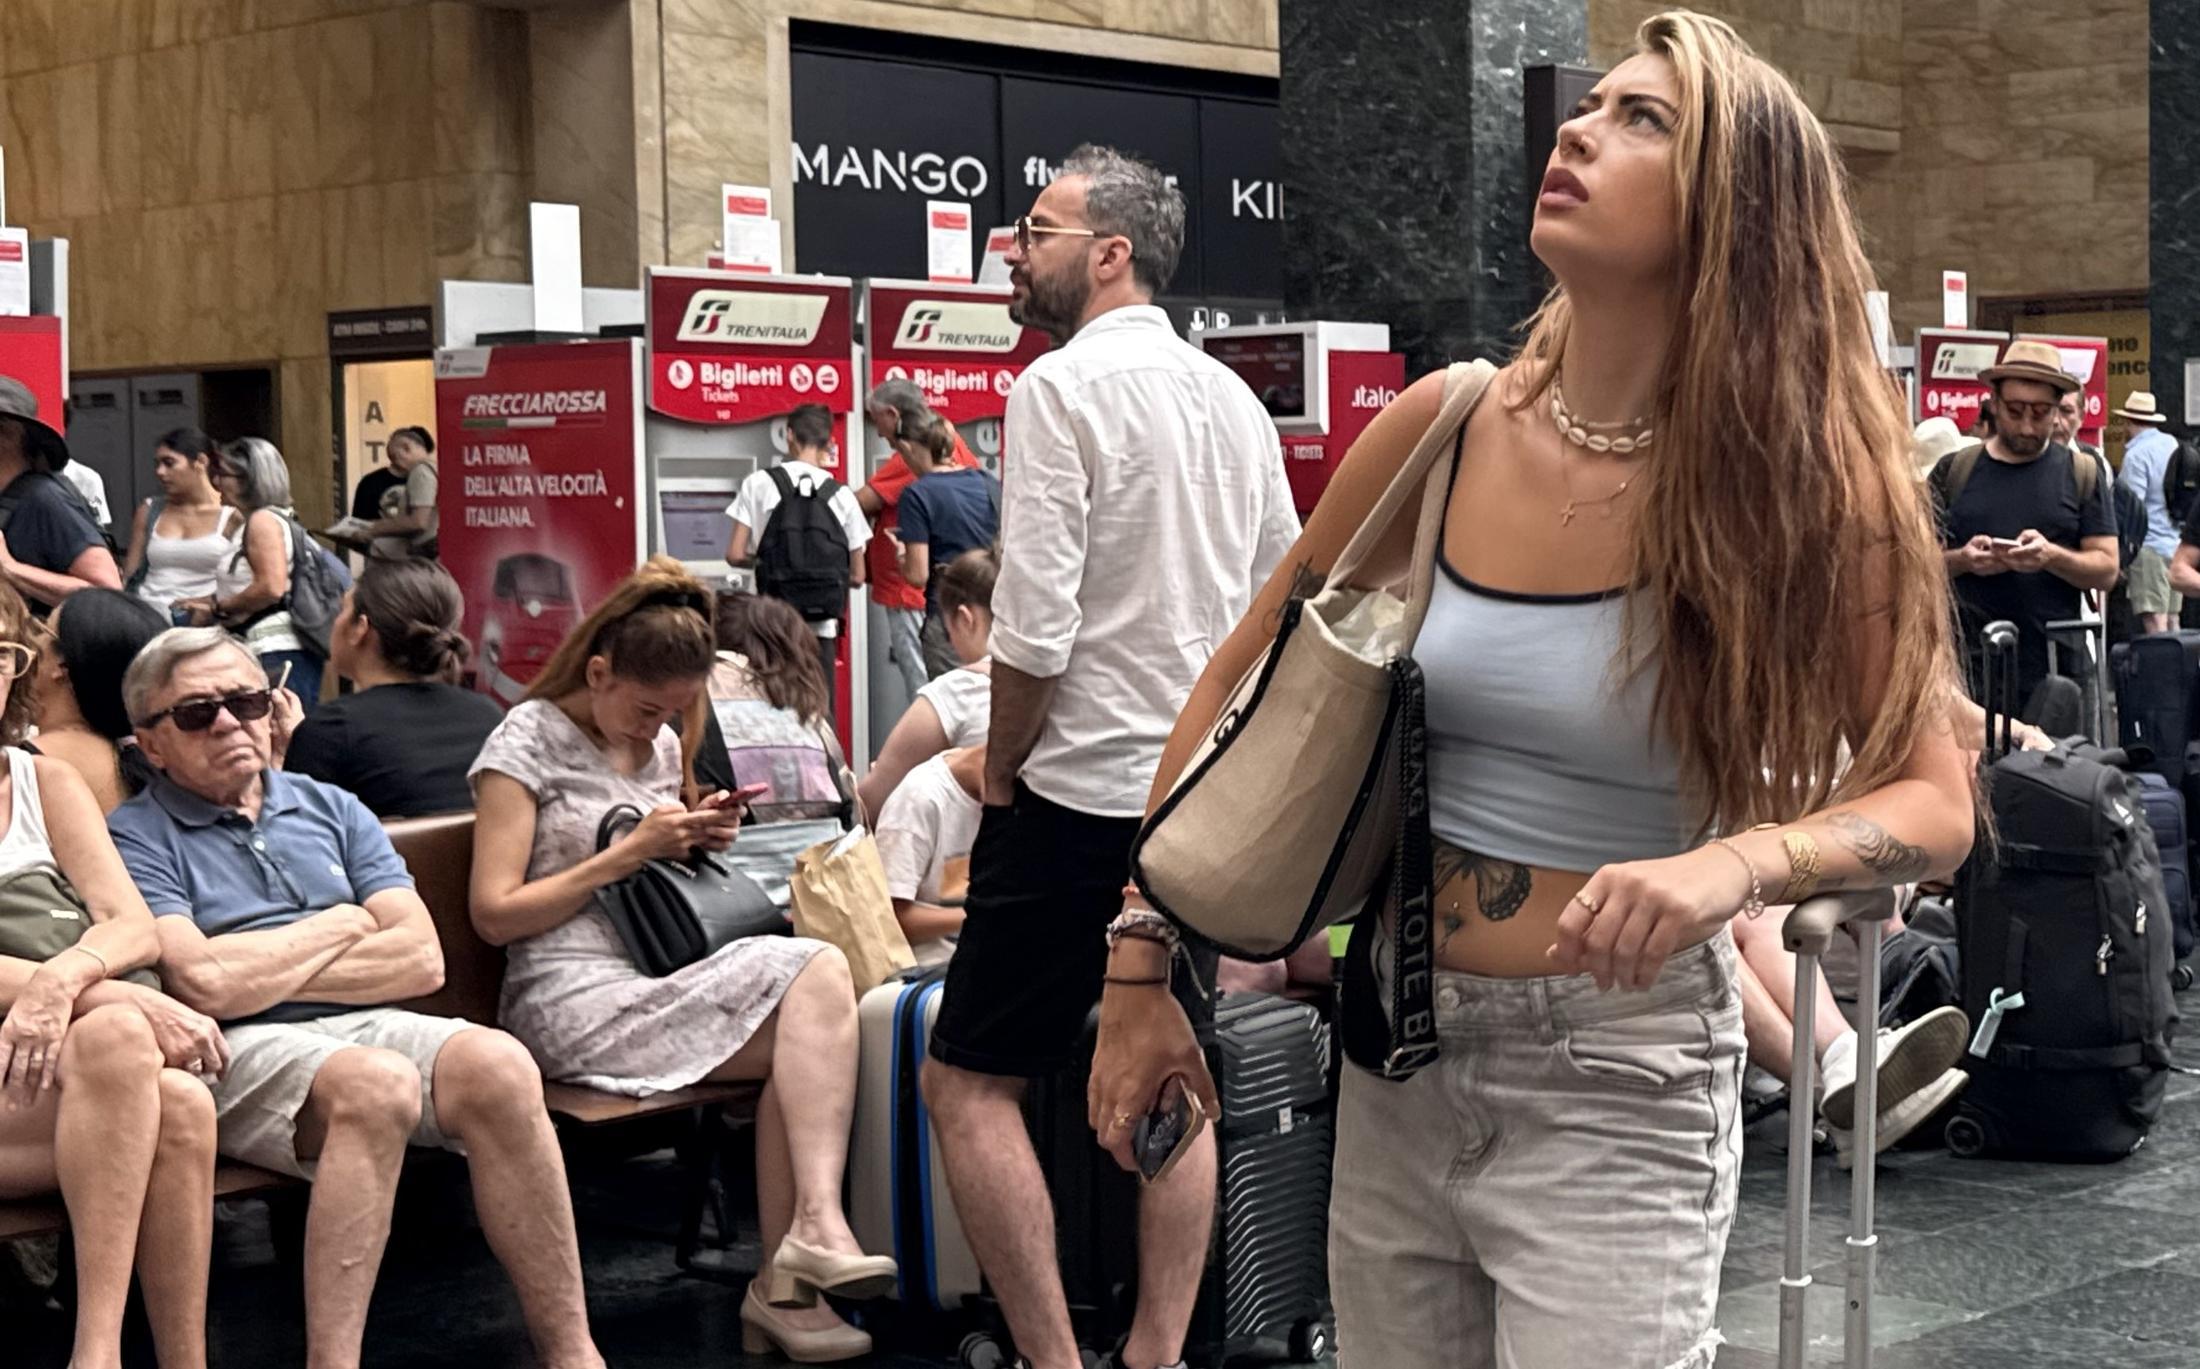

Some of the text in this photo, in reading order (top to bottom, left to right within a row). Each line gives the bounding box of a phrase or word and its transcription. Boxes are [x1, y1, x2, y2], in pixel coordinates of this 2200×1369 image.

[791, 142, 988, 197] MANGO
[726, 324, 808, 340] TRENITALIA
[938, 333, 1011, 348] TRENITALIA
[700, 362, 783, 391] Biglietti
[914, 368, 989, 395] Biglietti
[463, 390, 607, 417] FRECCIAROSSA
[464, 444, 532, 467] LA FIRMA
[464, 467, 608, 498] DELL'ALTA VELOCITÀ
[465, 506, 535, 527] ITALIANA.
[1403, 884, 1429, 1001] TOTE
